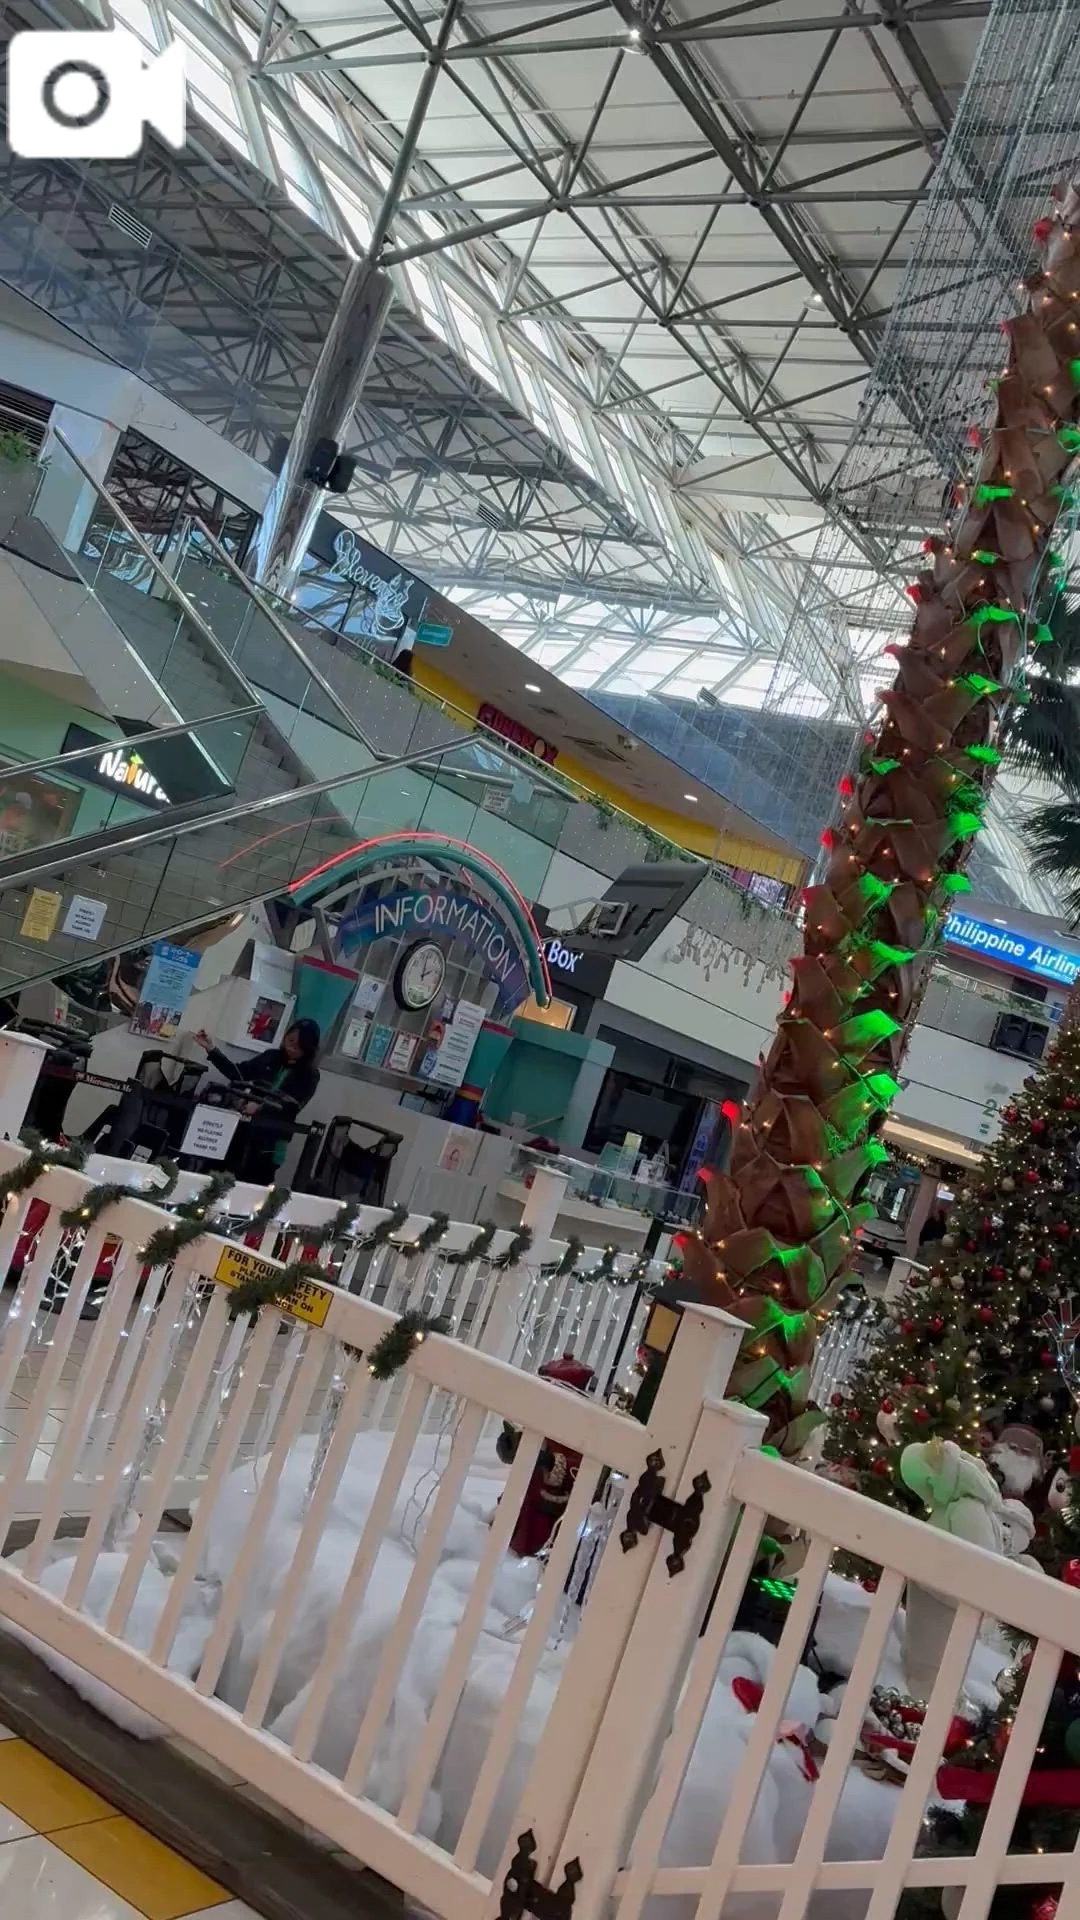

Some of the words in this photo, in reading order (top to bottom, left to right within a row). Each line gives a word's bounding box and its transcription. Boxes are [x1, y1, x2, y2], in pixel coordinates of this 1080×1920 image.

[375, 894, 516, 983] INFORMATION
[228, 1251, 249, 1267] FOR
[300, 1302, 314, 1313] ON
